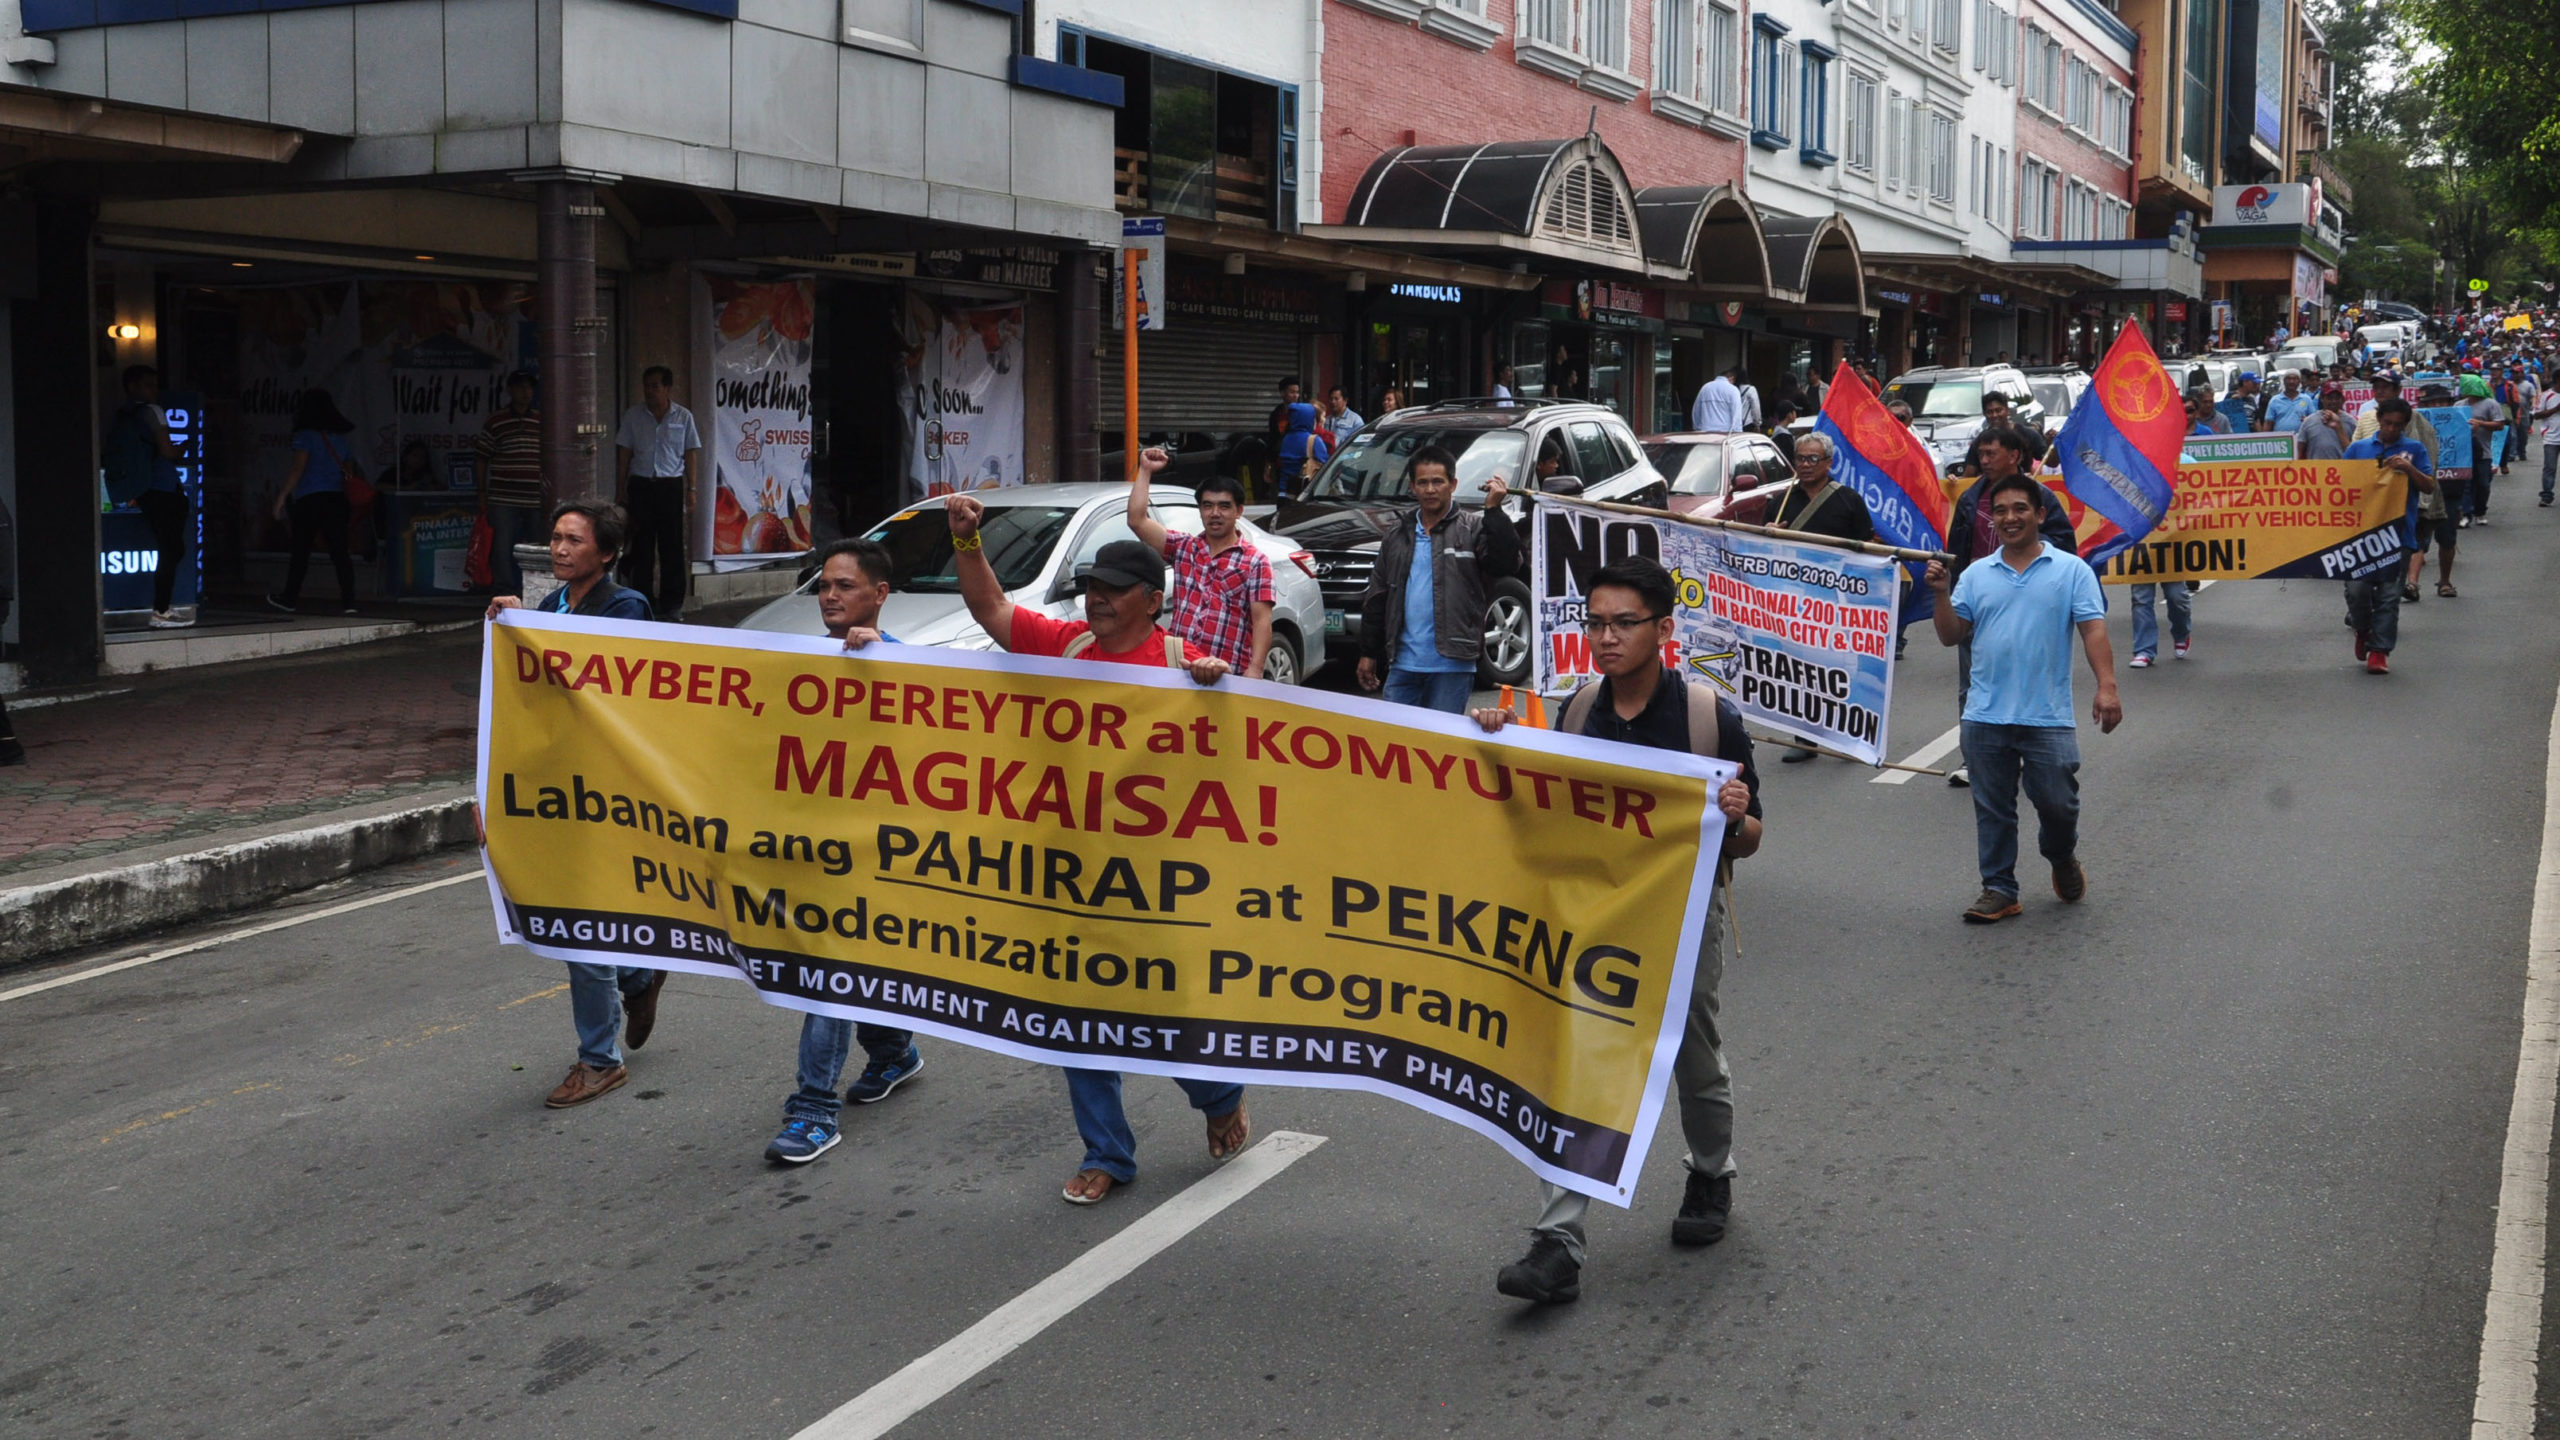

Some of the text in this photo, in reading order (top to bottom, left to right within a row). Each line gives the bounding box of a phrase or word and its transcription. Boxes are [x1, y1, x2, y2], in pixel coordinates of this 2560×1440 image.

[2236, 211, 2268, 221] VAGA
[1004, 261, 1052, 288] WAFFLES
[1390, 283, 1461, 303] STARBUCKS
[393, 375, 442, 414] Wait
[449, 376, 481, 424] for
[764, 430, 809, 446] SWISS
[2214, 441, 2288, 457] ASSOCIATIONS
[2175, 467, 2341, 489] POLIZATION &
[2328, 488, 2361, 507] OF
[2176, 511, 2250, 531] UTILITY
[2255, 511, 2362, 528] VEHICLES!
[100, 550, 159, 575] SUN
[1720, 549, 1868, 595] LTFRB MC 2019-016
[2101, 538, 2246, 576] TATION!
[2320, 525, 2401, 578] PISTON
[2351, 562, 2377, 579] METRO
[1707, 572, 1889, 635] ADDITIONAL 200 TAXIS
[1712, 596, 1887, 659] IN BAGUIO CITY & CAR
[1739, 643, 1849, 700] TRAFFIC
[1742, 674, 1880, 746] POLLUTION
[516, 645, 1657, 838] DRAYBER, OPEREYTOR at KOMYUTER
[774, 735, 1278, 846] MAGKAISA!
[503, 772, 1641, 1009] Labanan ang PAHIRAP at PEKENG
[632, 855, 1508, 1049] PUV Modernization Program
[529, 916, 656, 946] BAGUIO
[799, 966, 990, 1022] MOVEMENT
[1001, 1007, 1181, 1051] AGAINST
[1199, 1031, 1389, 1068] JEEPNEY
[1406, 1054, 1511, 1118] PHASE
[1518, 1105, 1576, 1154] OUT
